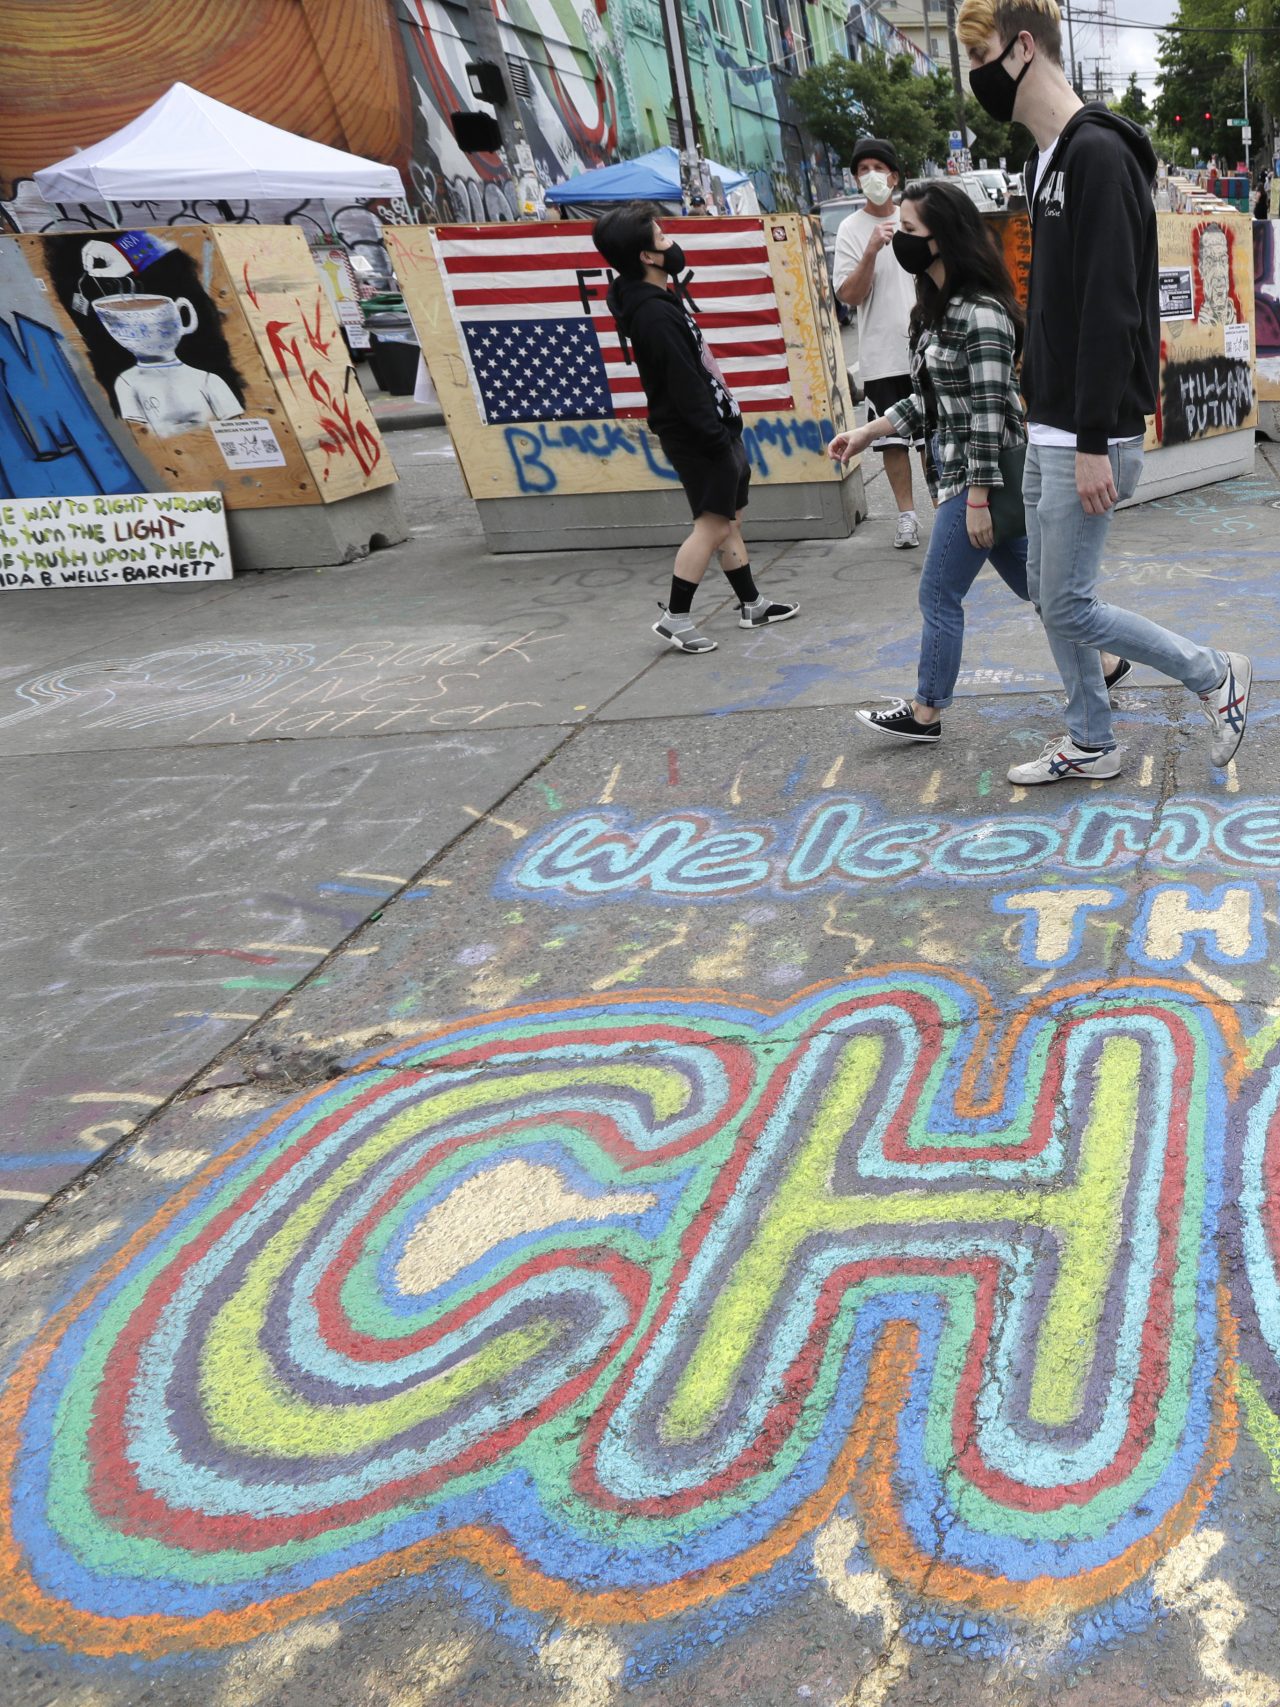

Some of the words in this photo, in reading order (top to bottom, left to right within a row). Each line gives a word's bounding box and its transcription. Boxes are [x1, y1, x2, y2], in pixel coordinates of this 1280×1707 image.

[119, 233, 140, 250] USA
[1185, 399, 1237, 436] PUTIN
[22, 500, 61, 521] WAY
[93, 496, 147, 516] RIGHT
[67, 523, 106, 543] THE
[114, 515, 185, 542] LIGHT
[93, 547, 146, 567] UPON
